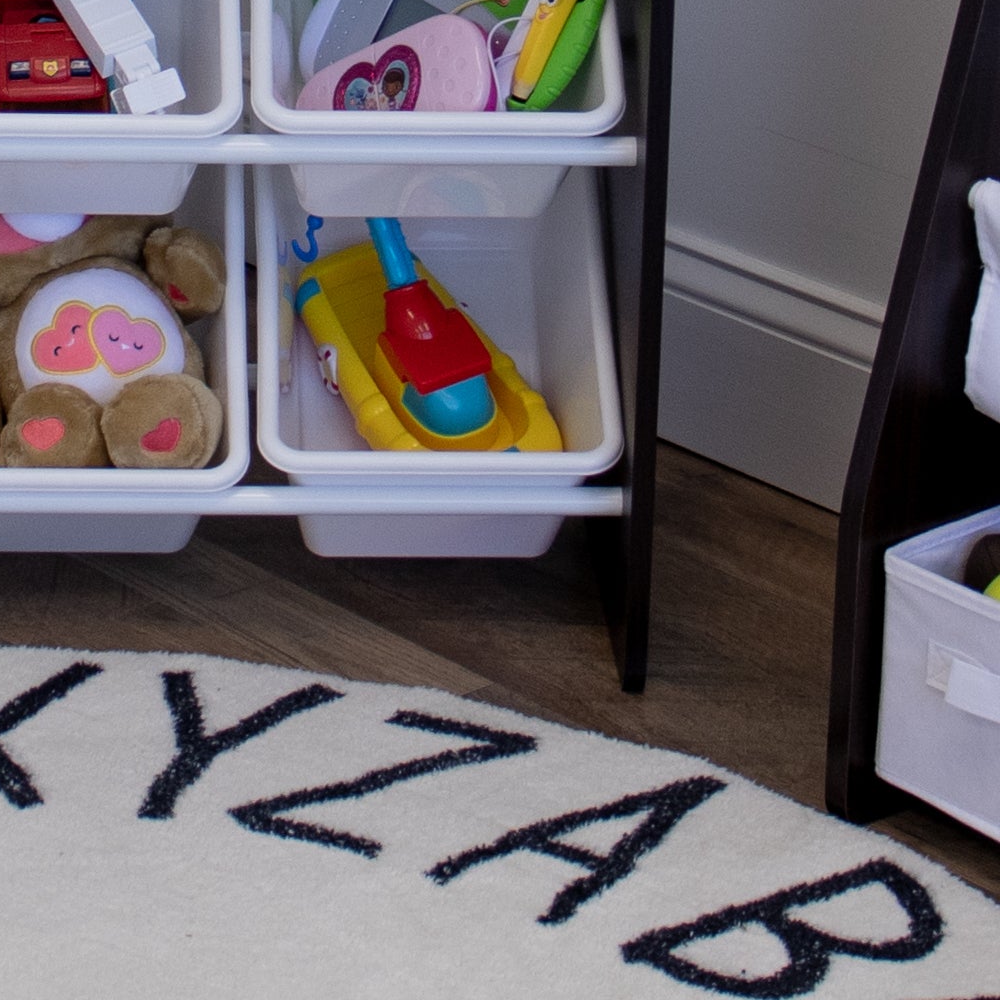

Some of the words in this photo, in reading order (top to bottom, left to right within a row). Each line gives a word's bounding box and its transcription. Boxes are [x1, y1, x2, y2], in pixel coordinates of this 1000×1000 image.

[136, 670, 346, 820] Y
[227, 708, 539, 859] Z
[422, 775, 728, 926] A
[619, 856, 944, 1000] B
